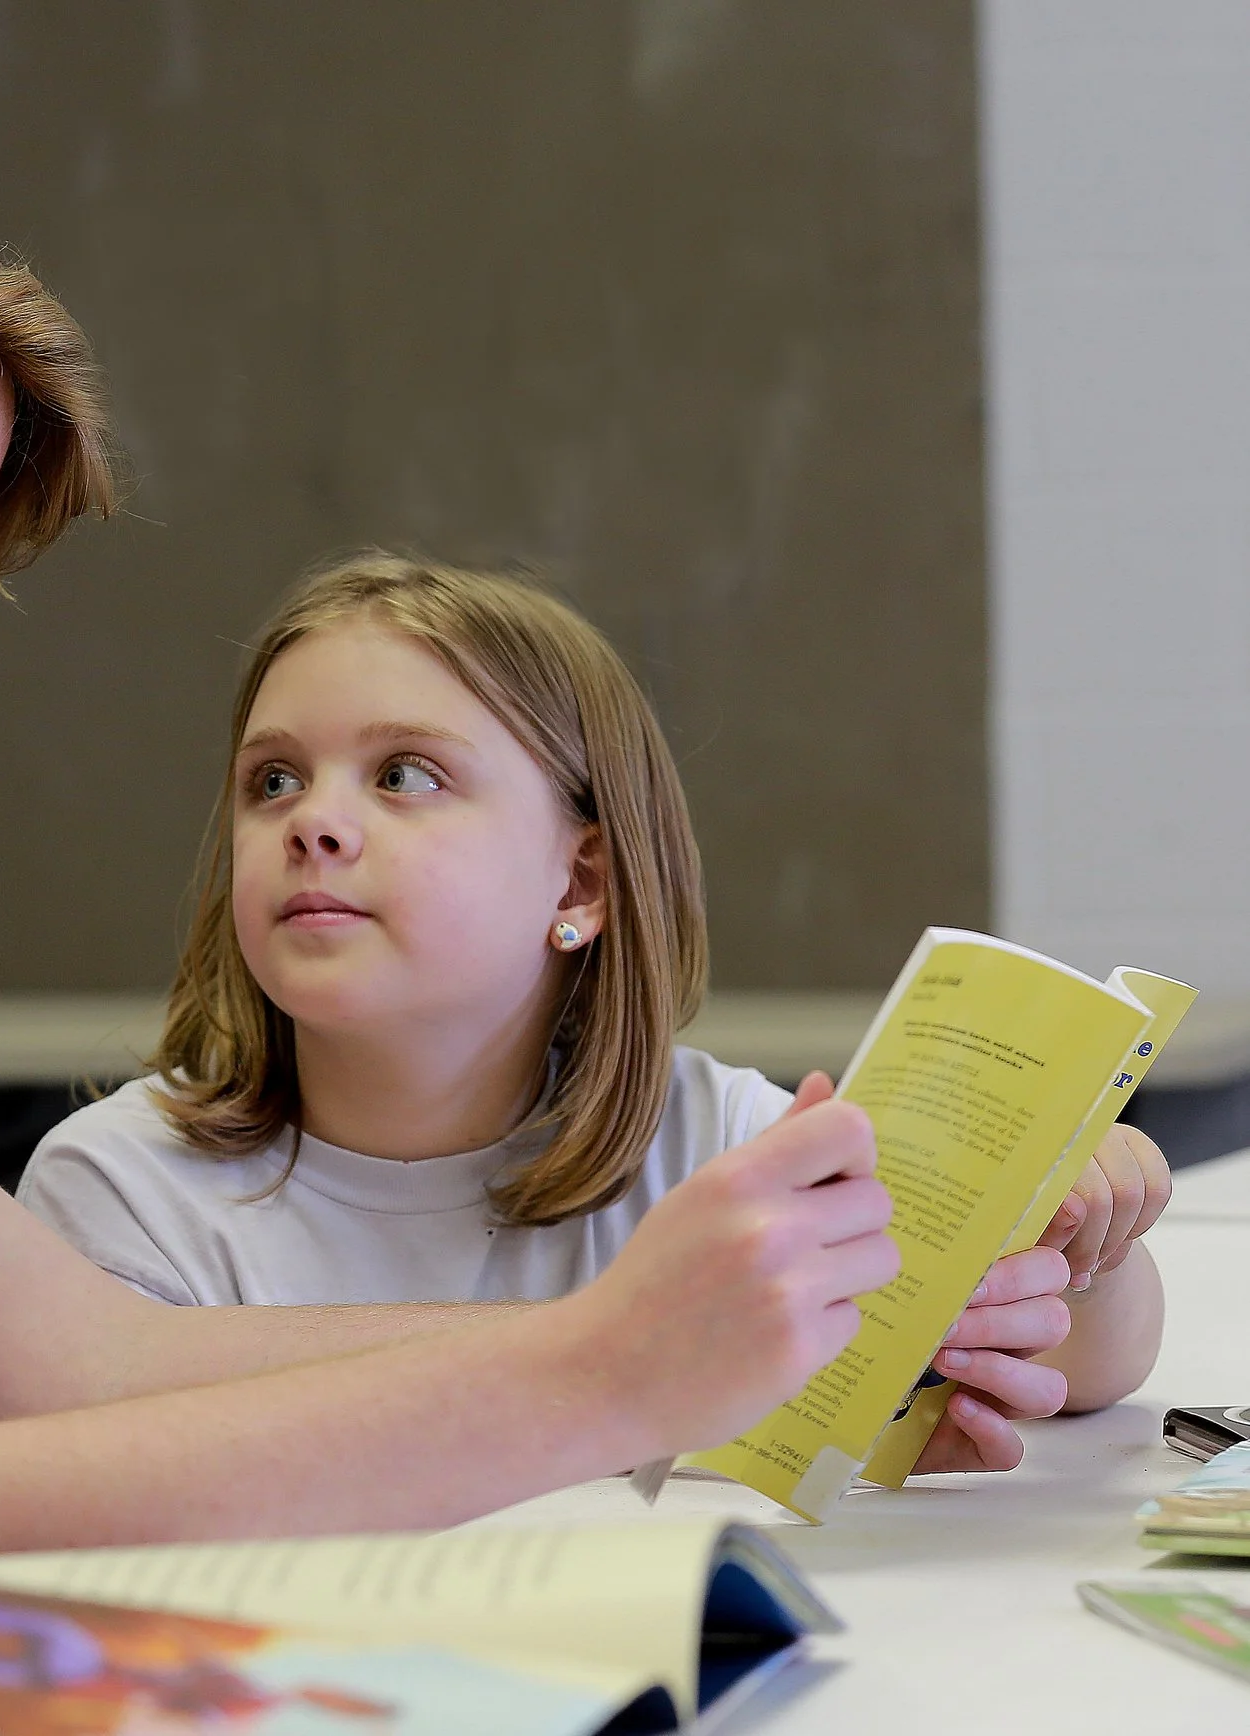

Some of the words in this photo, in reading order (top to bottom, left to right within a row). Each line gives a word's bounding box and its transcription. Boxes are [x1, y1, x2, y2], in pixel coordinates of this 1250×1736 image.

[1133, 1040, 1154, 1058] e
[1113, 1072, 1134, 1089] r
[801, 1395, 838, 1419] American
